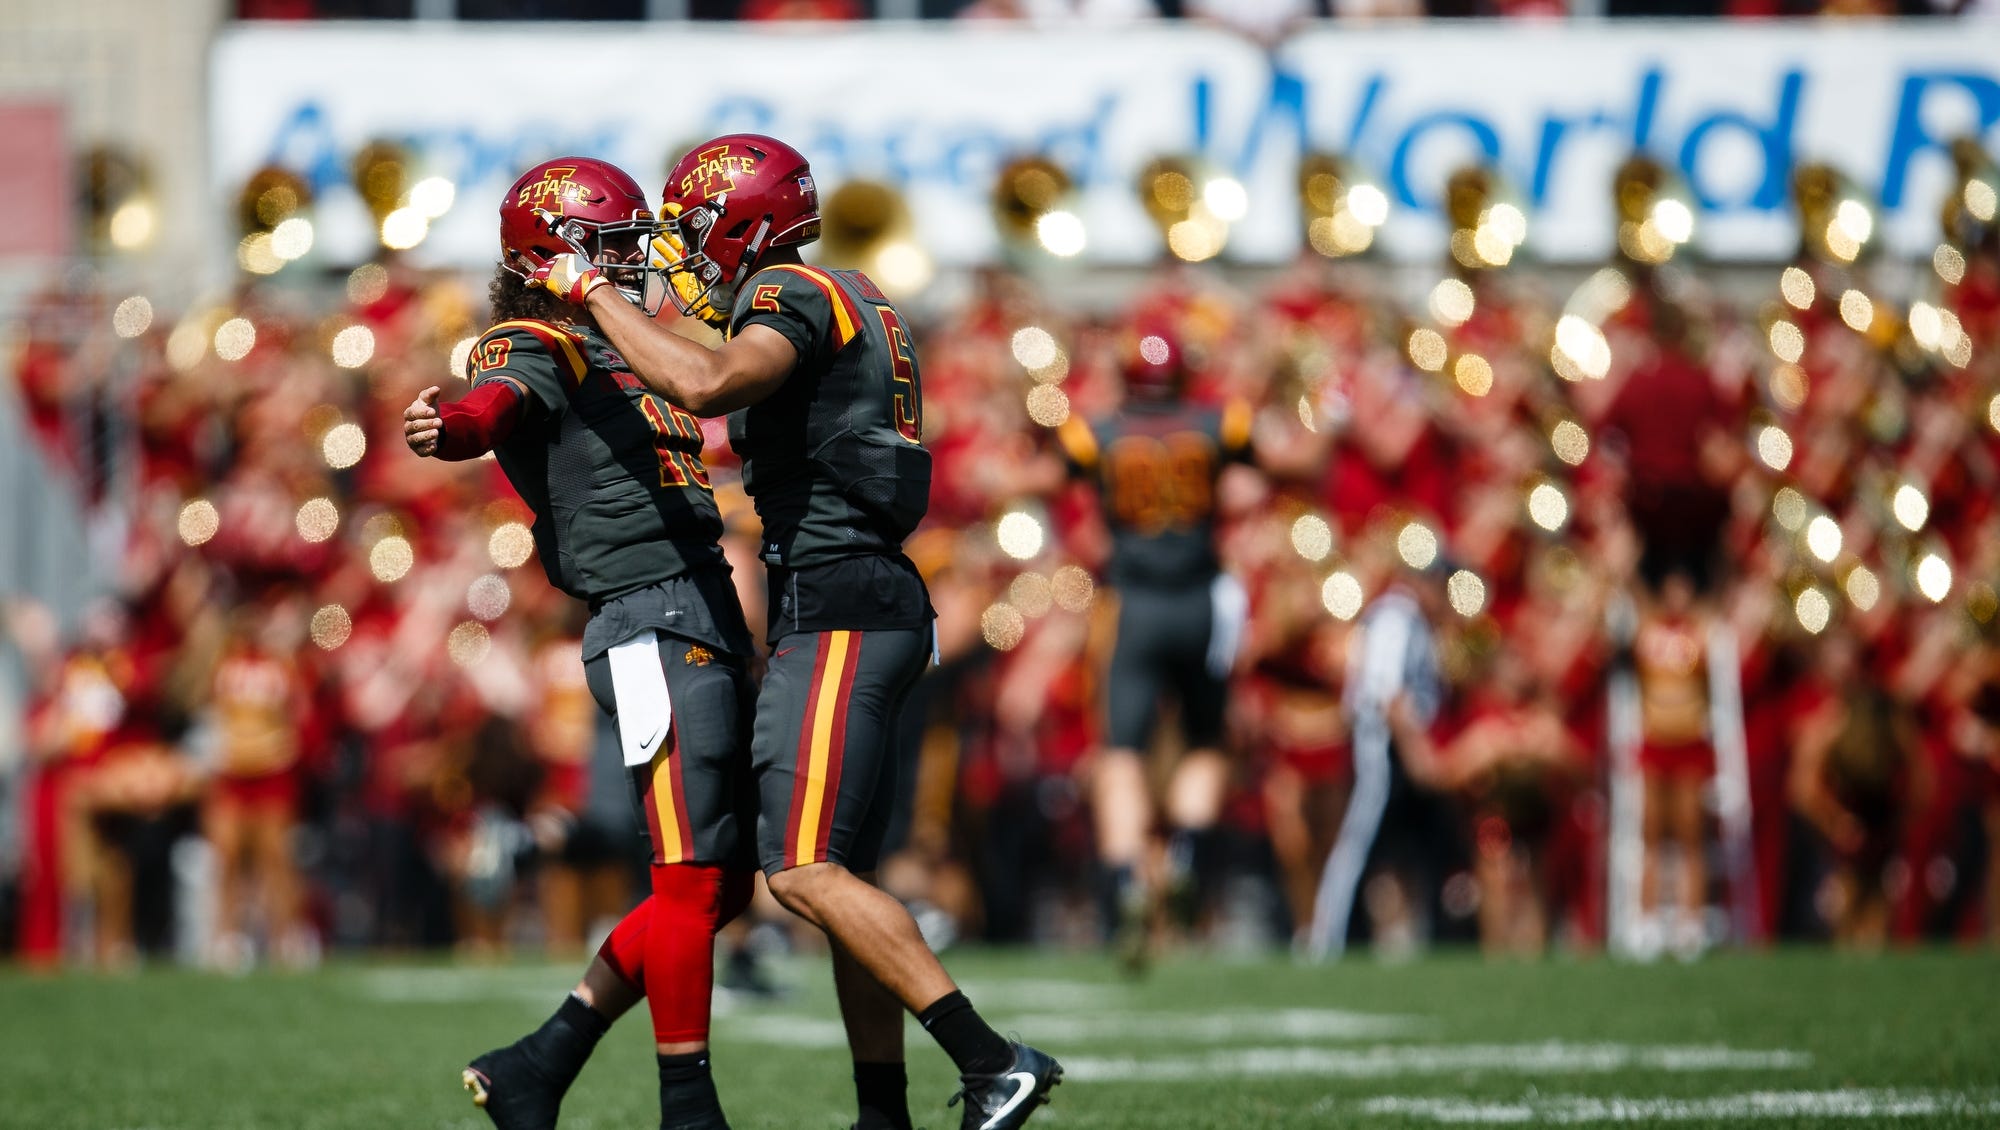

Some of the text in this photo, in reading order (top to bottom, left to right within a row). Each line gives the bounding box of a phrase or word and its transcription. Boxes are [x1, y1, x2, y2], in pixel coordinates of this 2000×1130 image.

[518, 179, 592, 208] STATE
[681, 156, 756, 198] STATE
[753, 284, 782, 313] 5
[876, 305, 921, 444] 5
[640, 393, 713, 489] 10
